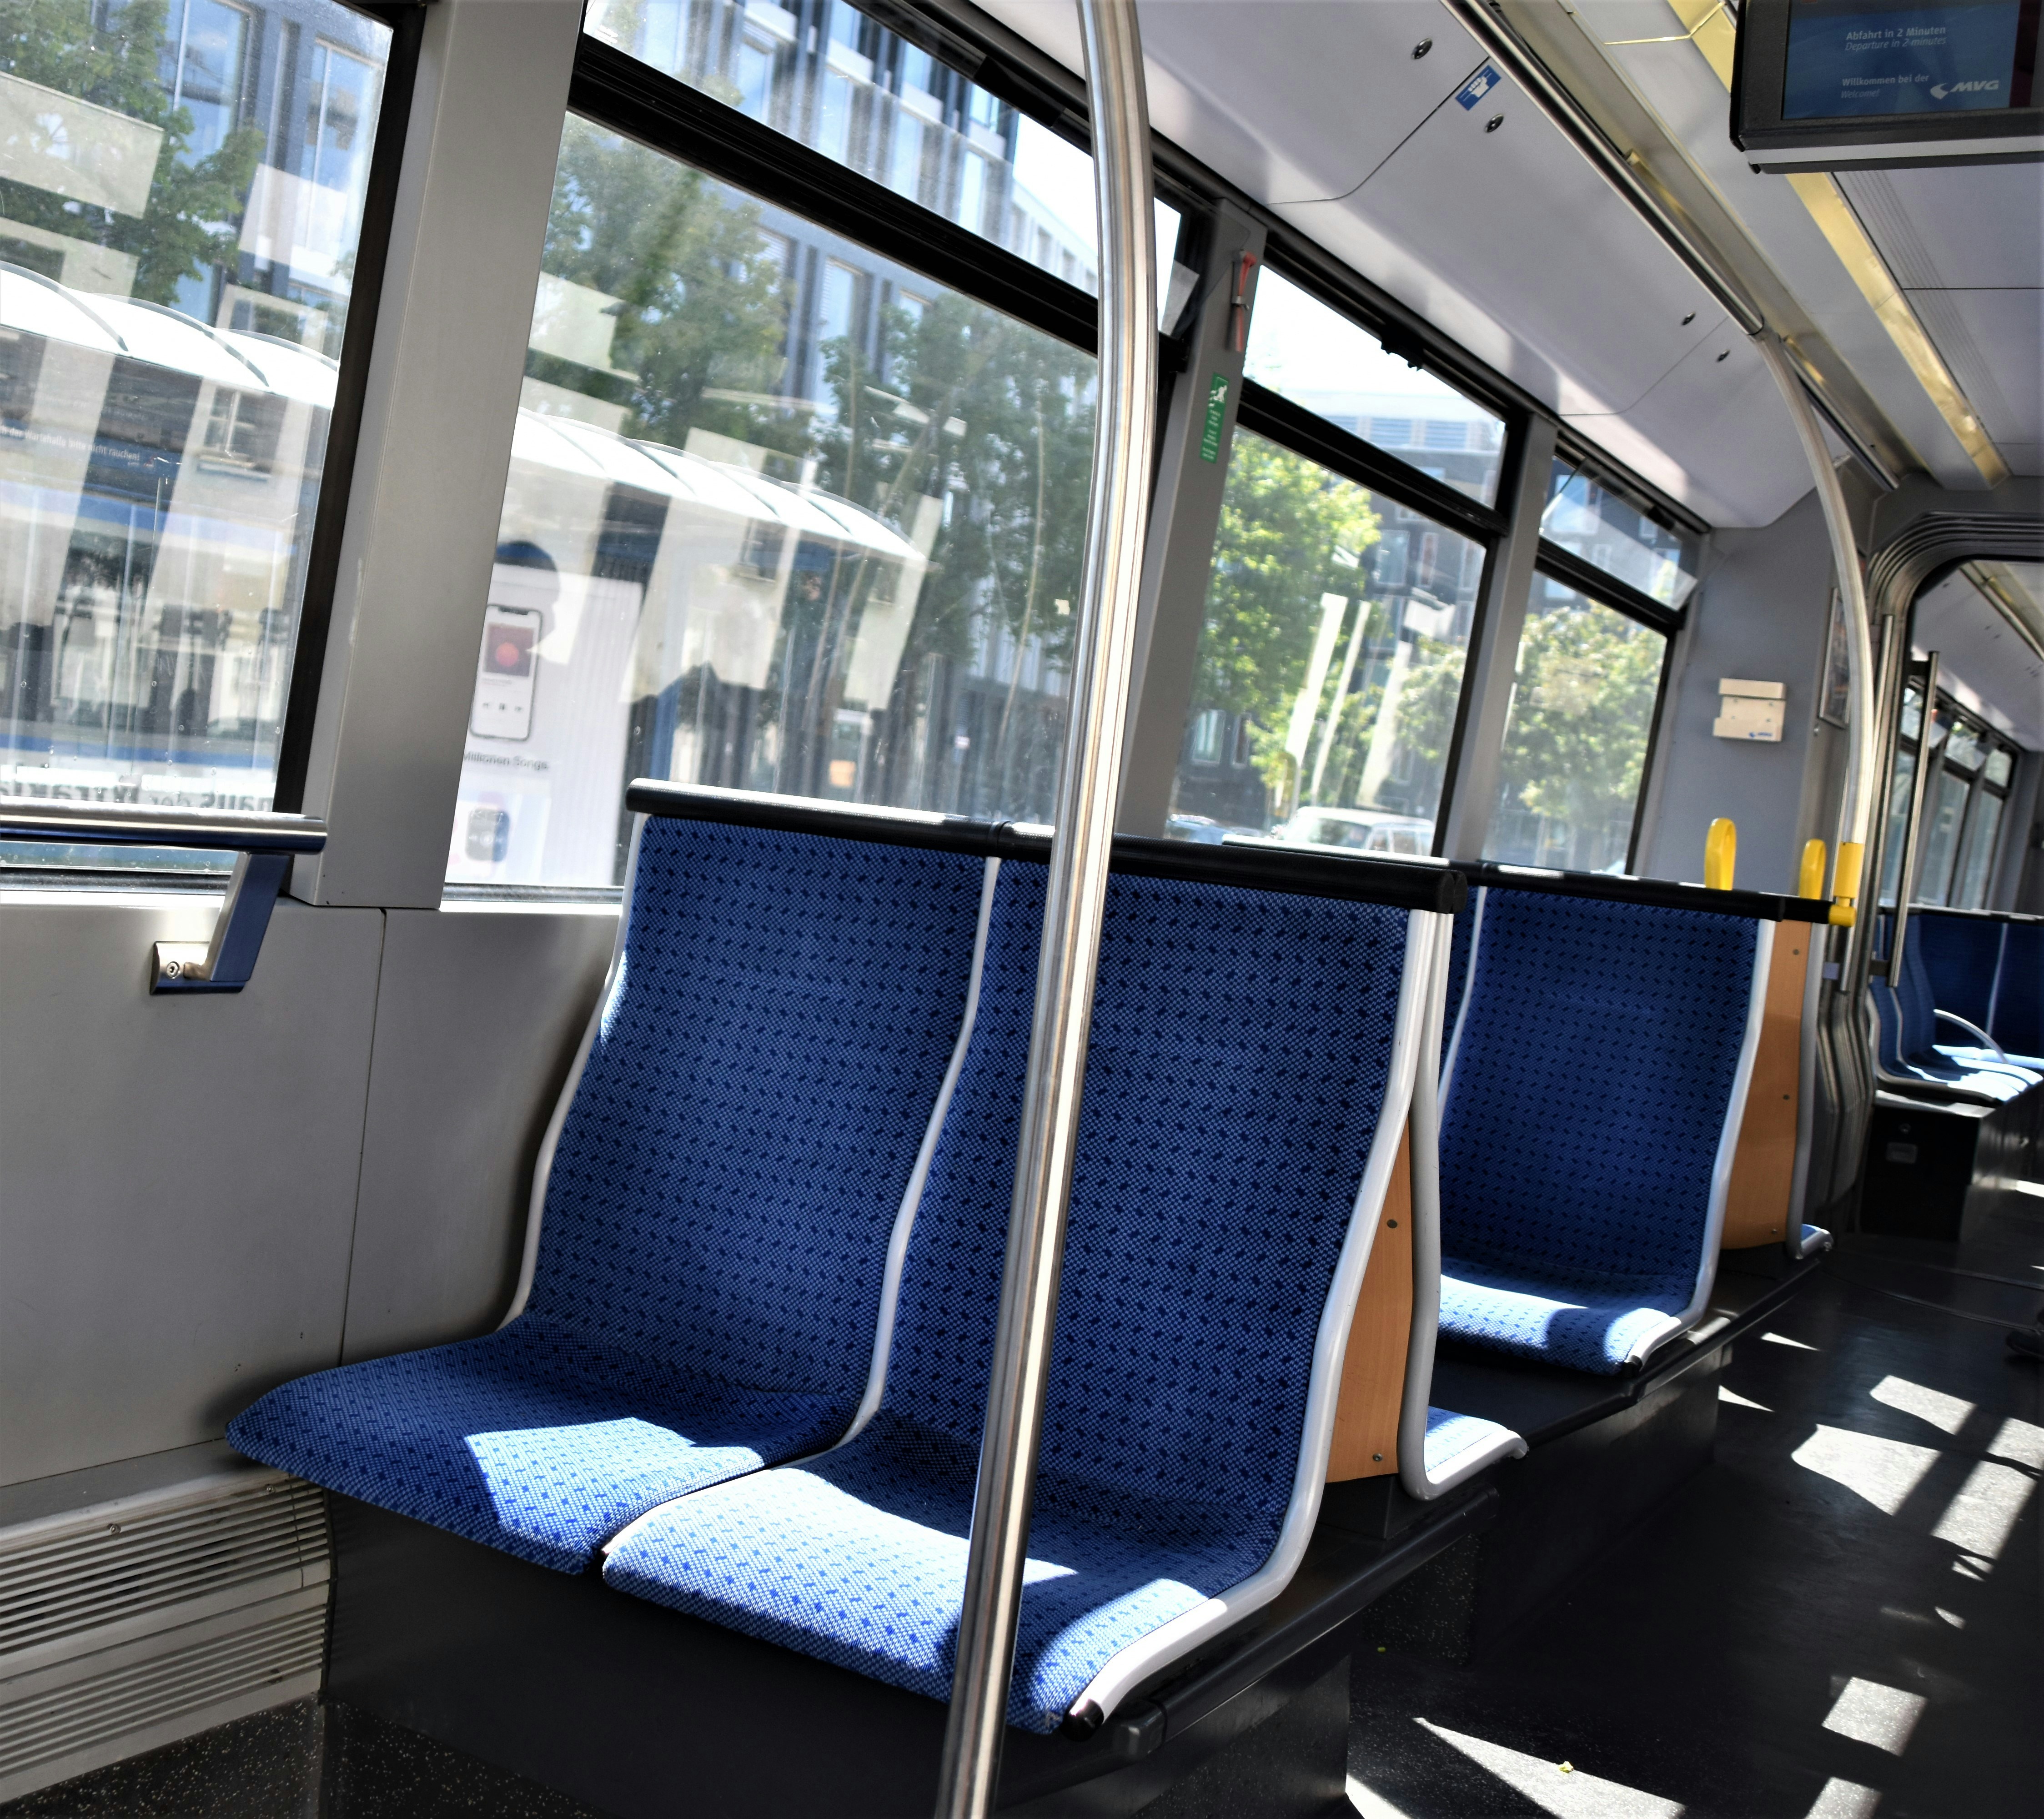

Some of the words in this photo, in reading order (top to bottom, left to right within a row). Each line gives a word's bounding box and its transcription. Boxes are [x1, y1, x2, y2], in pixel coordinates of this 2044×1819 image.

[1846, 30, 1882, 40] Abfahrt
[1885, 29, 1893, 38] in
[1897, 29, 1903, 37] 2
[1906, 26, 1946, 36] Minuten
[1845, 38, 1889, 51] Departure
[1902, 38, 1909, 47] 2
[1911, 36, 1946, 46] minutes
[1842, 77, 1895, 86] Willkommen
[1898, 75, 1912, 83] bei
[1914, 74, 1929, 83] der
[1950, 80, 1999, 92] MVG
[25, 430, 66, 447] Wartehalle
[68, 438, 86, 450] bitte
[109, 448, 140, 461] rauchen!
